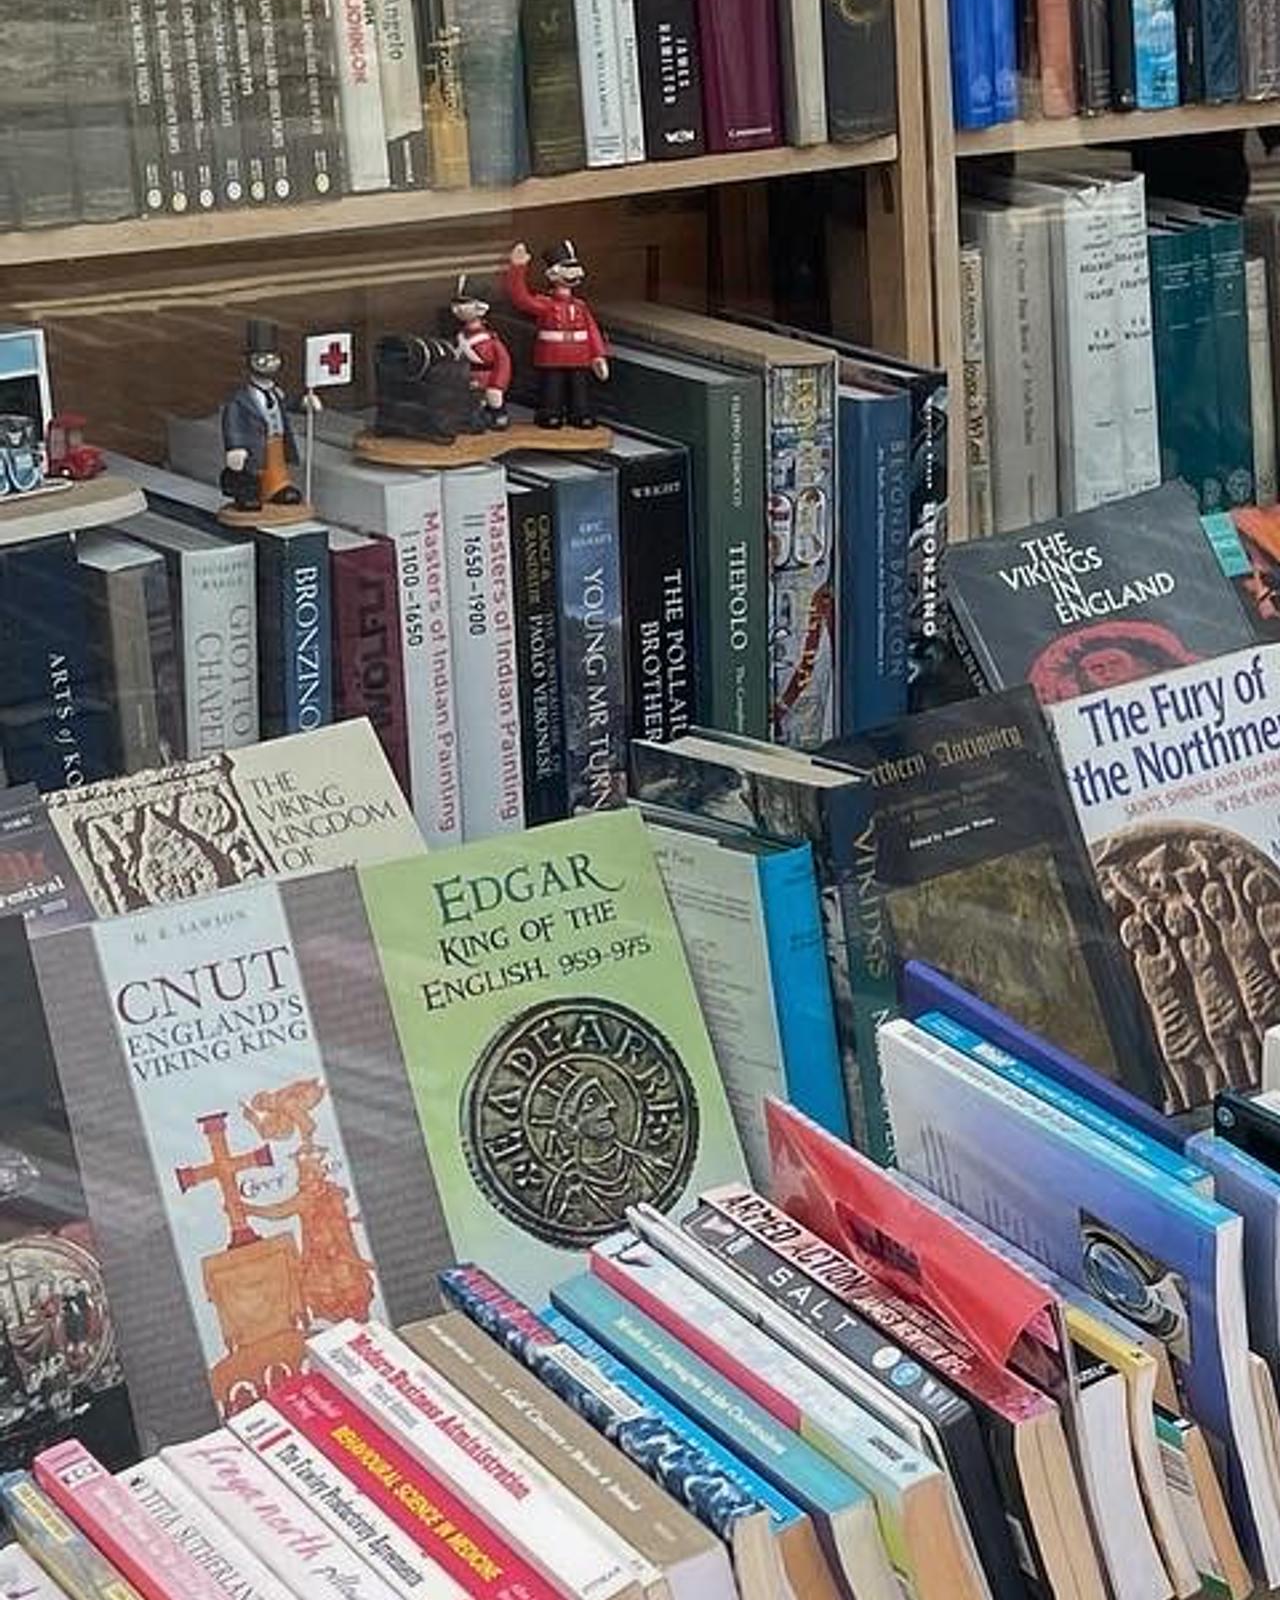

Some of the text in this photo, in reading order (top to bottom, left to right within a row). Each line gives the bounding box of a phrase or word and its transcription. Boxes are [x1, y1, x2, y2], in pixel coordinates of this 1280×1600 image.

[423, 512, 441, 612] Masters
[488, 503, 506, 601] Masters
[920, 501, 938, 637] BRONZINO
[1000, 547, 1103, 591] VIKINGS
[1021, 531, 1074, 566] THE
[579, 567, 609, 676] YOUNG
[662, 569, 683, 622] THE
[727, 541, 748, 650] TIEPOLO
[1051, 576, 1082, 602] IN
[1056, 572, 1175, 625] ENGLAND
[230, 604, 252, 736] GIOTTO
[294, 566, 321, 730] BRONZINO
[497, 639, 514, 716] Indian
[524, 613, 549, 676] PAOLO
[50, 653, 74, 720] ARTS
[433, 649, 449, 726] Indian
[585, 684, 606, 728] MR
[1079, 654, 1266, 747] The Fury of
[250, 771, 298, 800] THE
[256, 785, 345, 824] VIKING
[439, 732, 456, 831] Painting
[501, 722, 519, 820] Painting
[1073, 759, 1131, 806] the
[268, 801, 398, 848] KINGDOM
[282, 847, 314, 870] OF
[432, 853, 625, 926] EDGAR
[438, 899, 617, 968] KING OF THE
[558, 933, 652, 976] 959-975
[117, 946, 290, 1026] CNUT
[127, 994, 304, 1058] ENGLAND'S
[132, 1021, 308, 1082] VIKING KING
[721, 1181, 873, 1304] ARMED ACTION
[767, 1267, 857, 1332] SALT
[345, 1330, 400, 1379] Modern
[387, 1368, 448, 1423] Business
[431, 1410, 537, 1504] Administration
